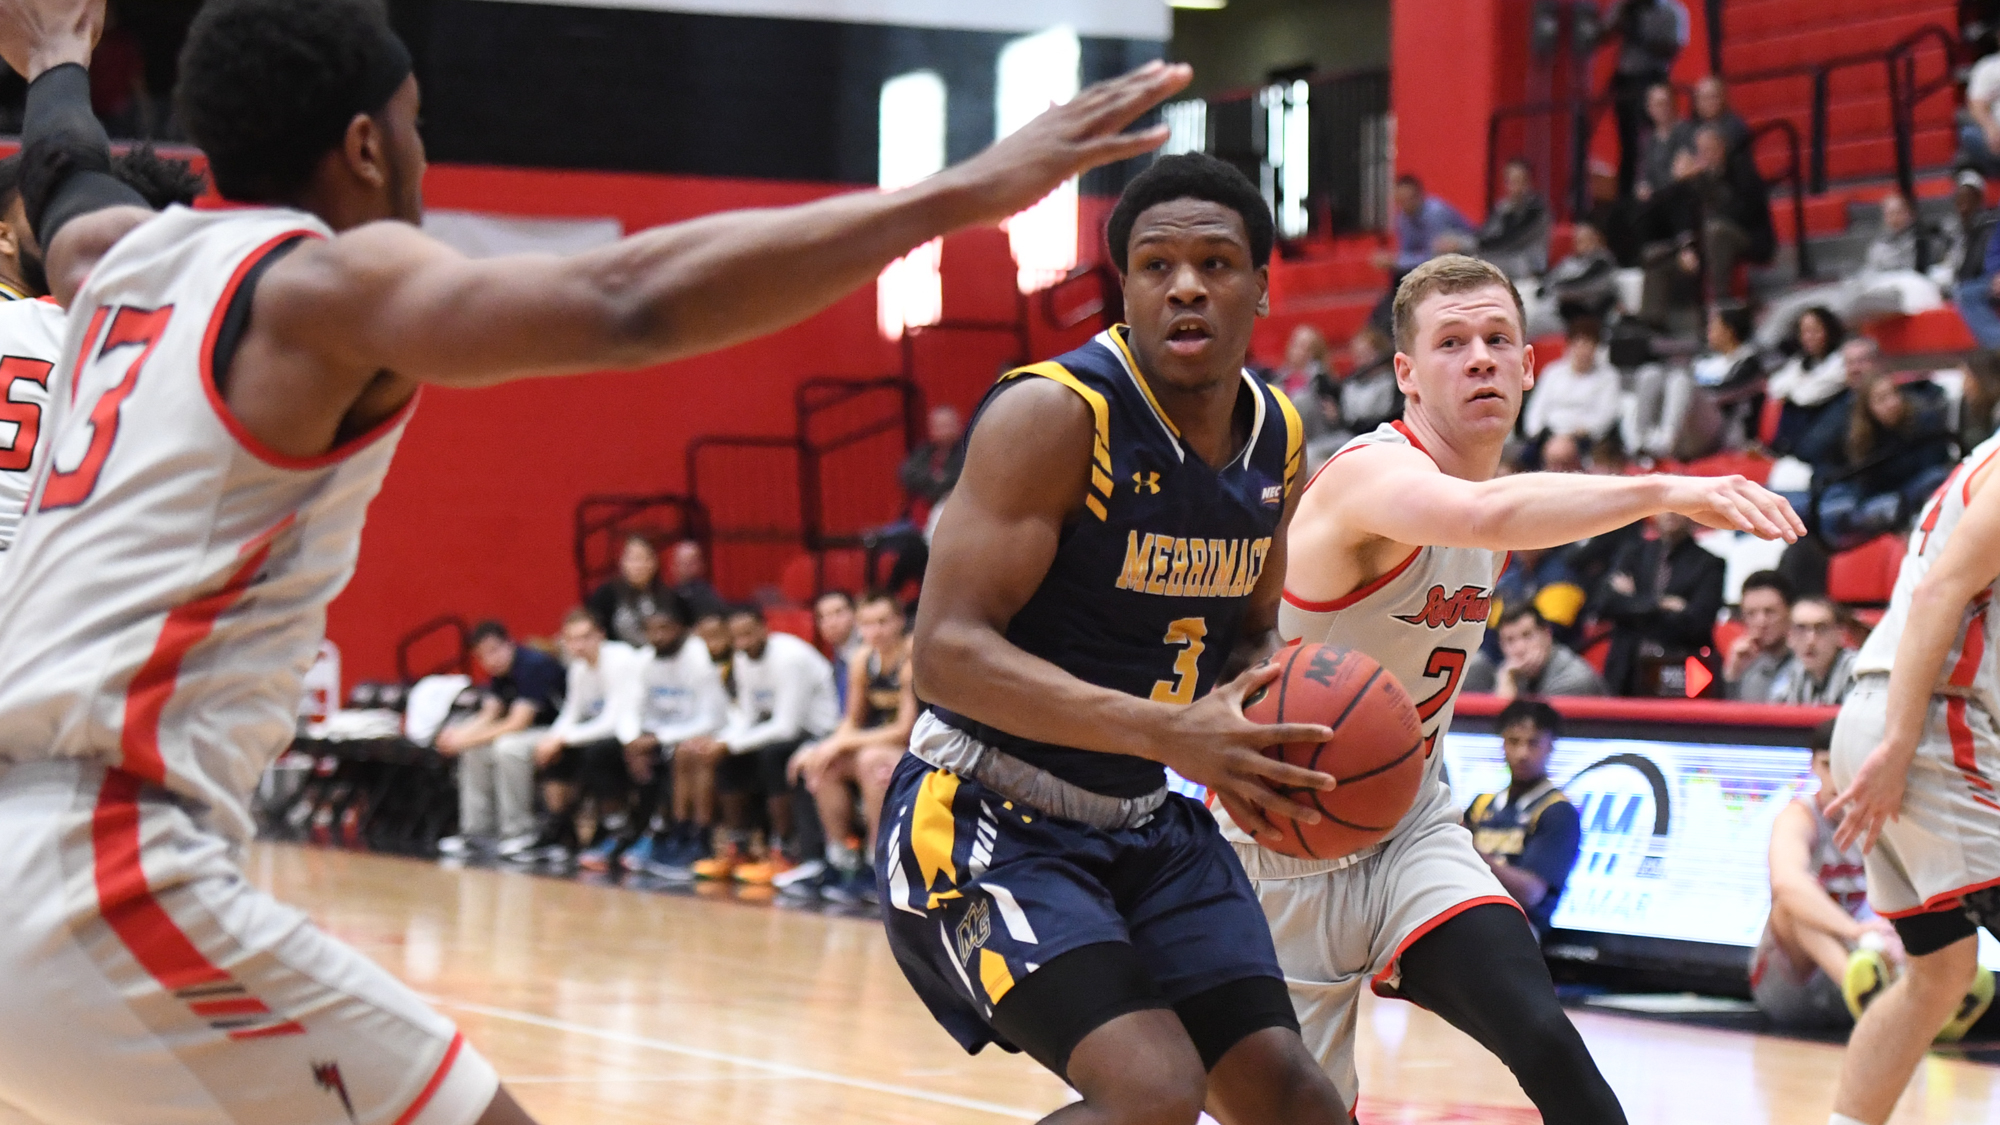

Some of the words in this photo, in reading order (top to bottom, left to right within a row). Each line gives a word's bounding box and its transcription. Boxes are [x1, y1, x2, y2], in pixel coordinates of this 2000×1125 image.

[1261, 485, 1282, 500] NEC
[1150, 617, 1207, 704] 3
[1415, 646, 1467, 760] 2
